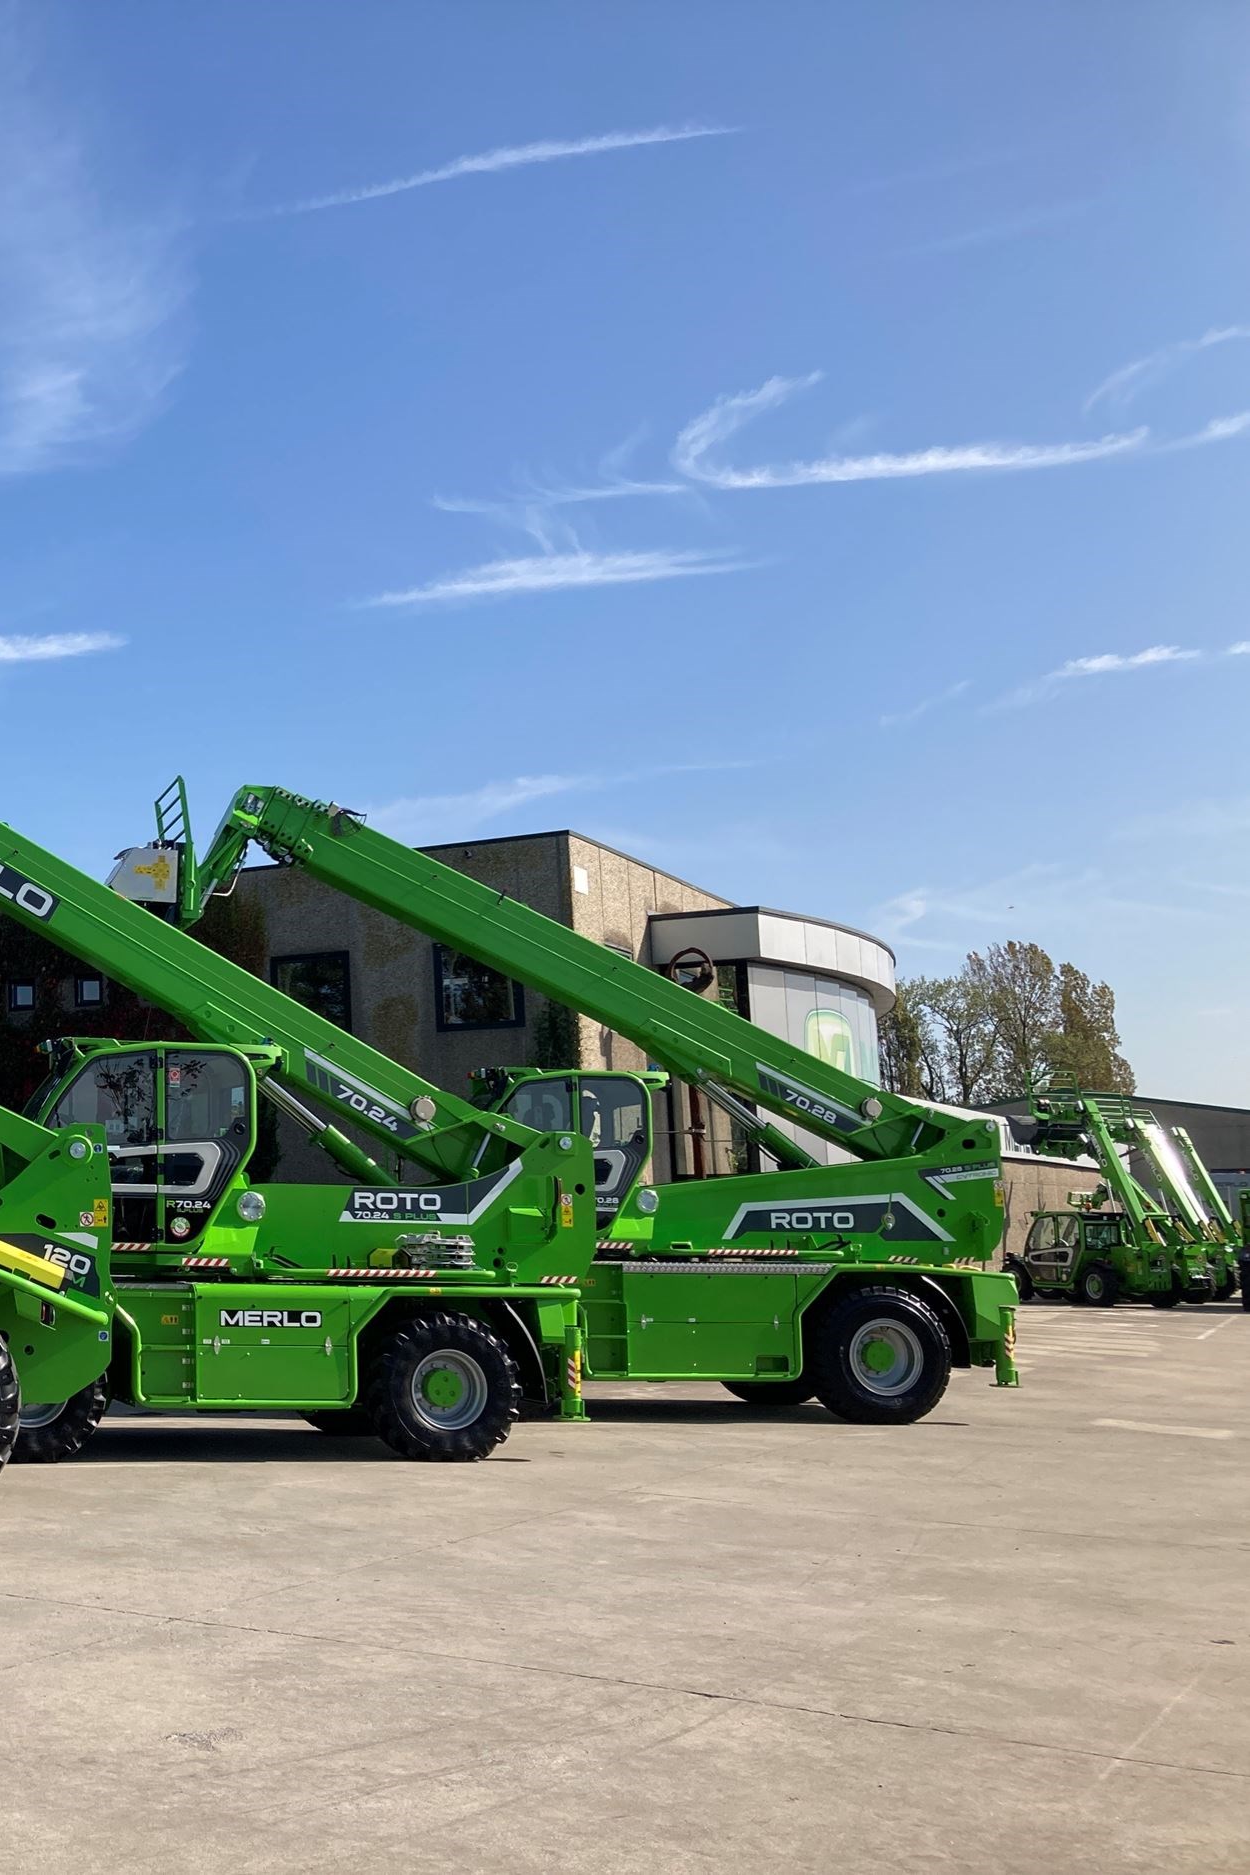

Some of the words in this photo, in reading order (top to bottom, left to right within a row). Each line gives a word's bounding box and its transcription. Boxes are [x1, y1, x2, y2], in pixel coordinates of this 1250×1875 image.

[336, 1084, 398, 1132] 70.24
[785, 1088, 837, 1125] 70.28
[166, 1200, 212, 1209] R70.24
[354, 1191, 442, 1211] ROTO
[354, 1211, 390, 1220] 70.24
[393, 1212, 402, 1220] S
[405, 1212, 437, 1220] PLUS
[770, 1212, 855, 1229] ROTO
[43, 1243, 92, 1275] 120
[220, 1310, 322, 1328] MERLO
